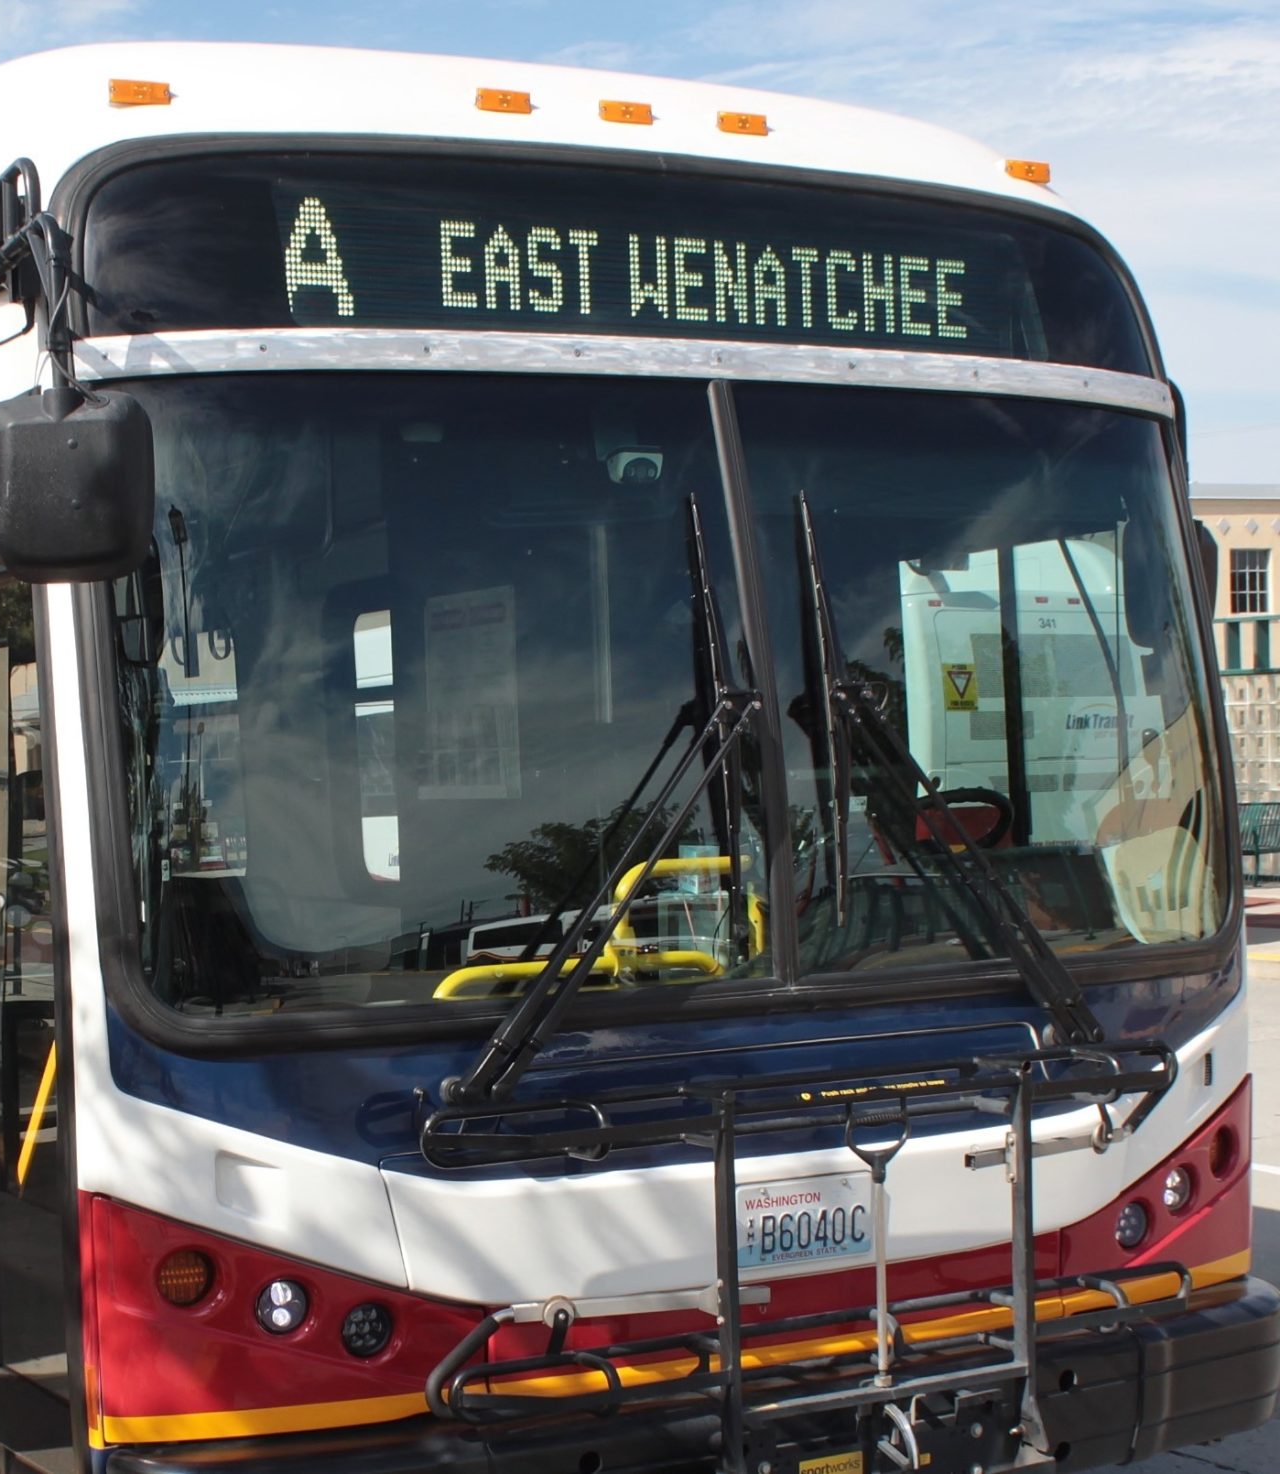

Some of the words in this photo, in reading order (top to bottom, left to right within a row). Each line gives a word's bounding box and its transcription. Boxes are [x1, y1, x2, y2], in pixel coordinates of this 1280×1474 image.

[284, 196, 355, 317] A
[439, 219, 598, 315] EAST
[628, 232, 968, 339] WENATCHEE
[1038, 618, 1057, 629] 341
[1066, 714, 1090, 730] Link
[745, 1192, 821, 1211] WASHINGTON
[761, 1204, 866, 1255] B6040C
[772, 1251, 814, 1262] EVERGREEN
[816, 1246, 838, 1256] STATE
